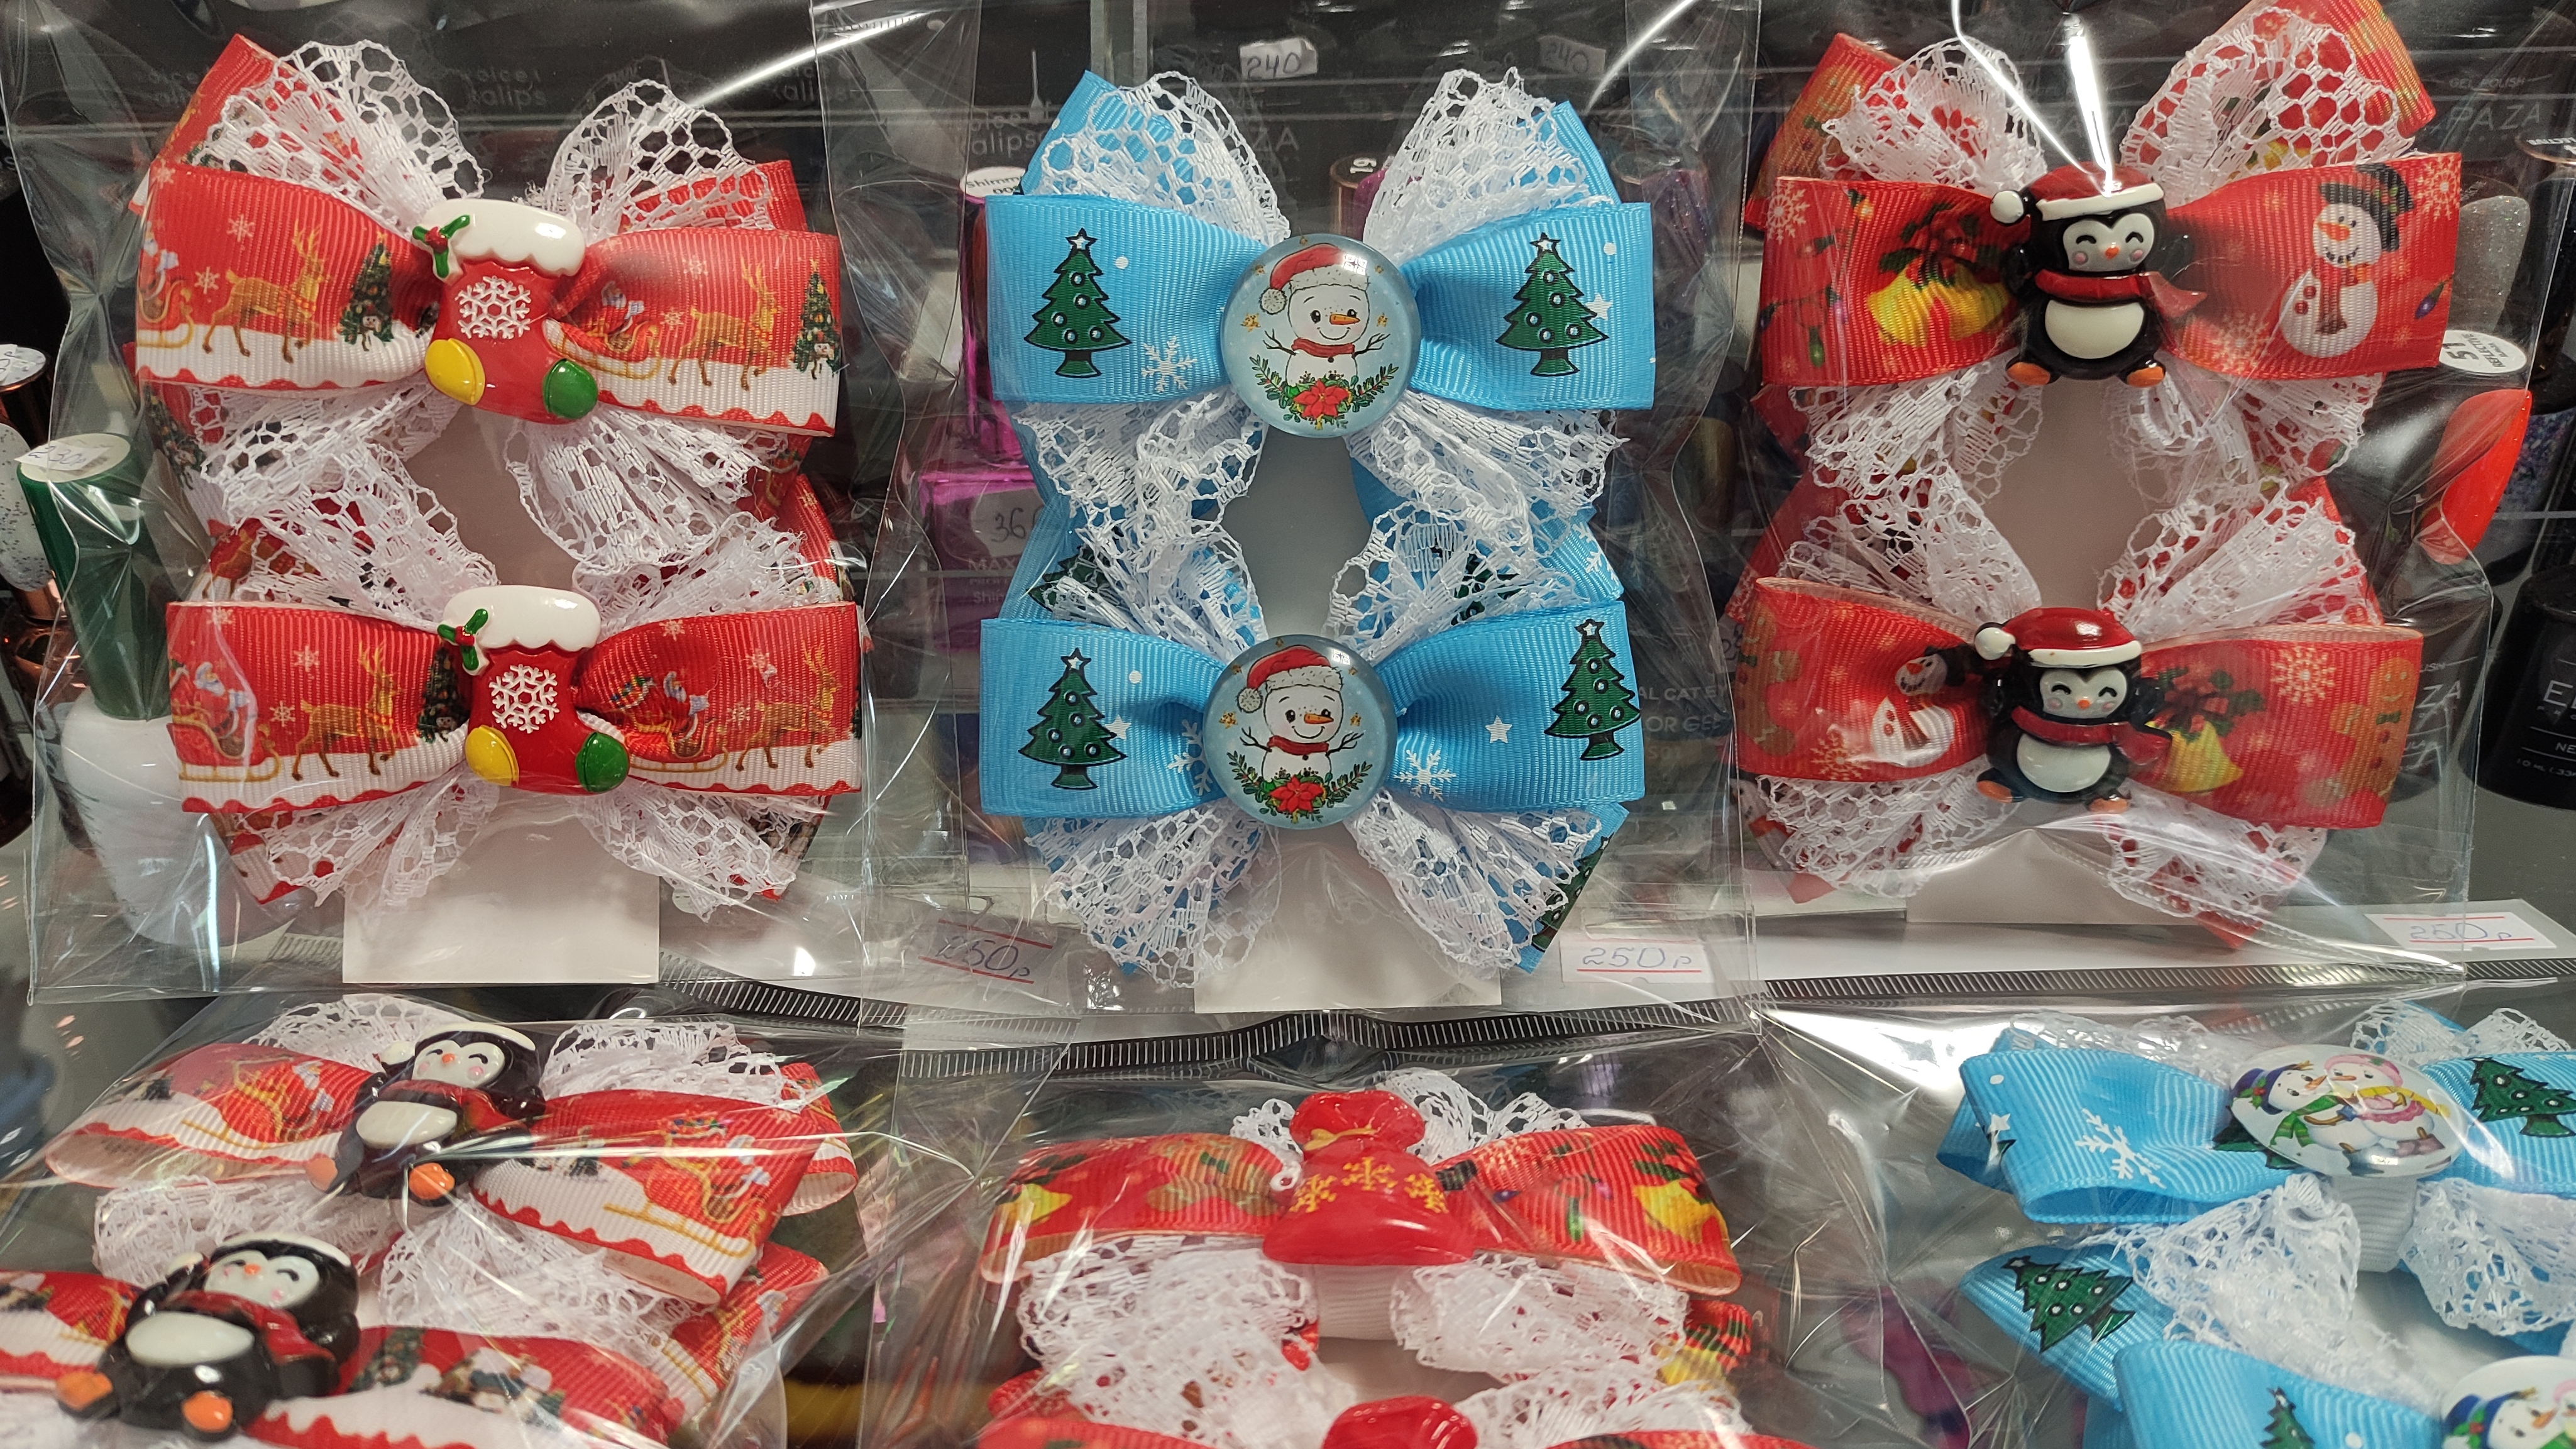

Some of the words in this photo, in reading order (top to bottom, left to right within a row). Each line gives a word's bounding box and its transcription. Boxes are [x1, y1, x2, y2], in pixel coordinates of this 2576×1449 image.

[1247, 52, 1302, 80] 240
[2461, 333, 2506, 368] REFLECTIVE
[1663, 686, 1702, 702] CAT
